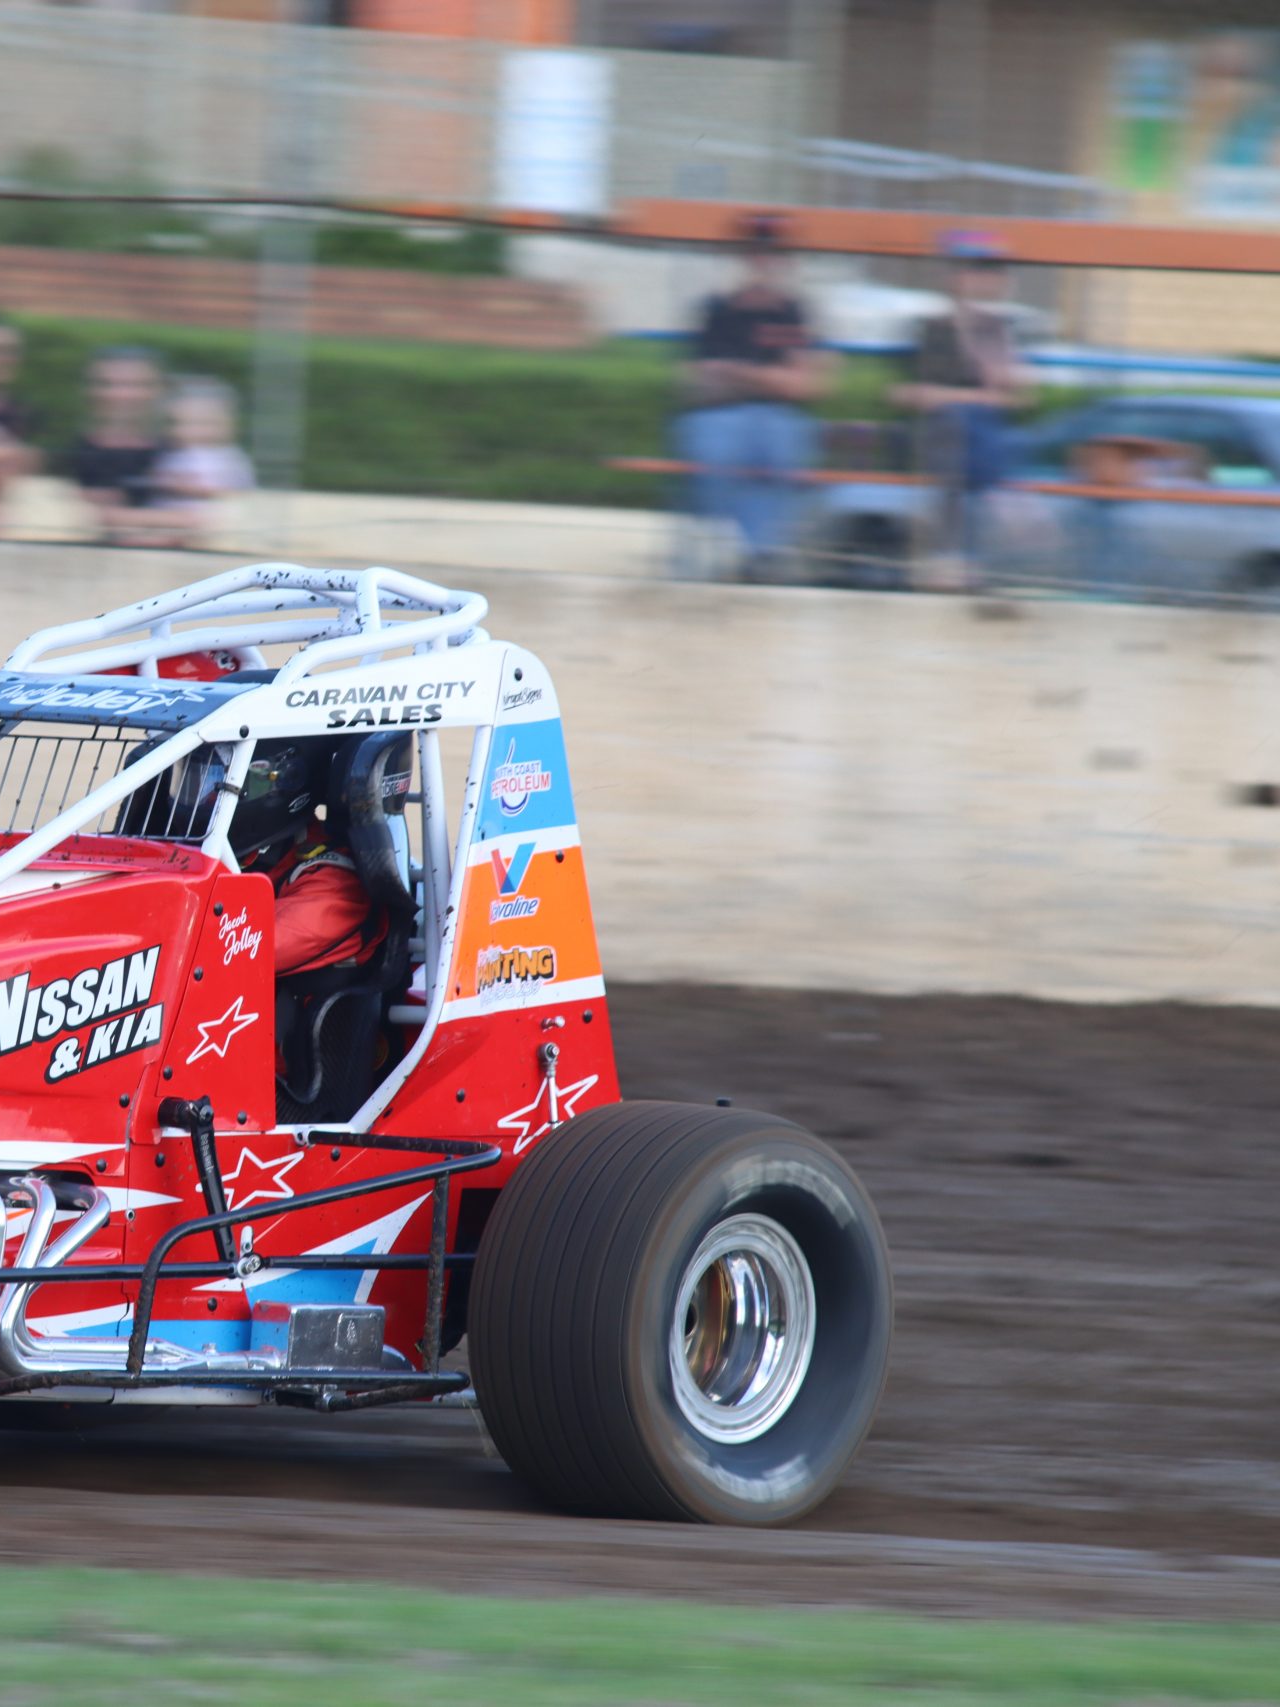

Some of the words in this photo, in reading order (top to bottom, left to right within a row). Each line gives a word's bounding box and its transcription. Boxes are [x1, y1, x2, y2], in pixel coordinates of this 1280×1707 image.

[9, 687, 157, 715] Jolley
[285, 684, 408, 708] CARAVAN
[416, 680, 476, 700] CITY
[326, 703, 443, 729] SALES
[515, 761, 540, 776] COAST
[218, 906, 247, 940] Jacob
[223, 926, 263, 966] Jolley
[47, 1036, 82, 1083] &
[86, 1005, 163, 1067] KIA
